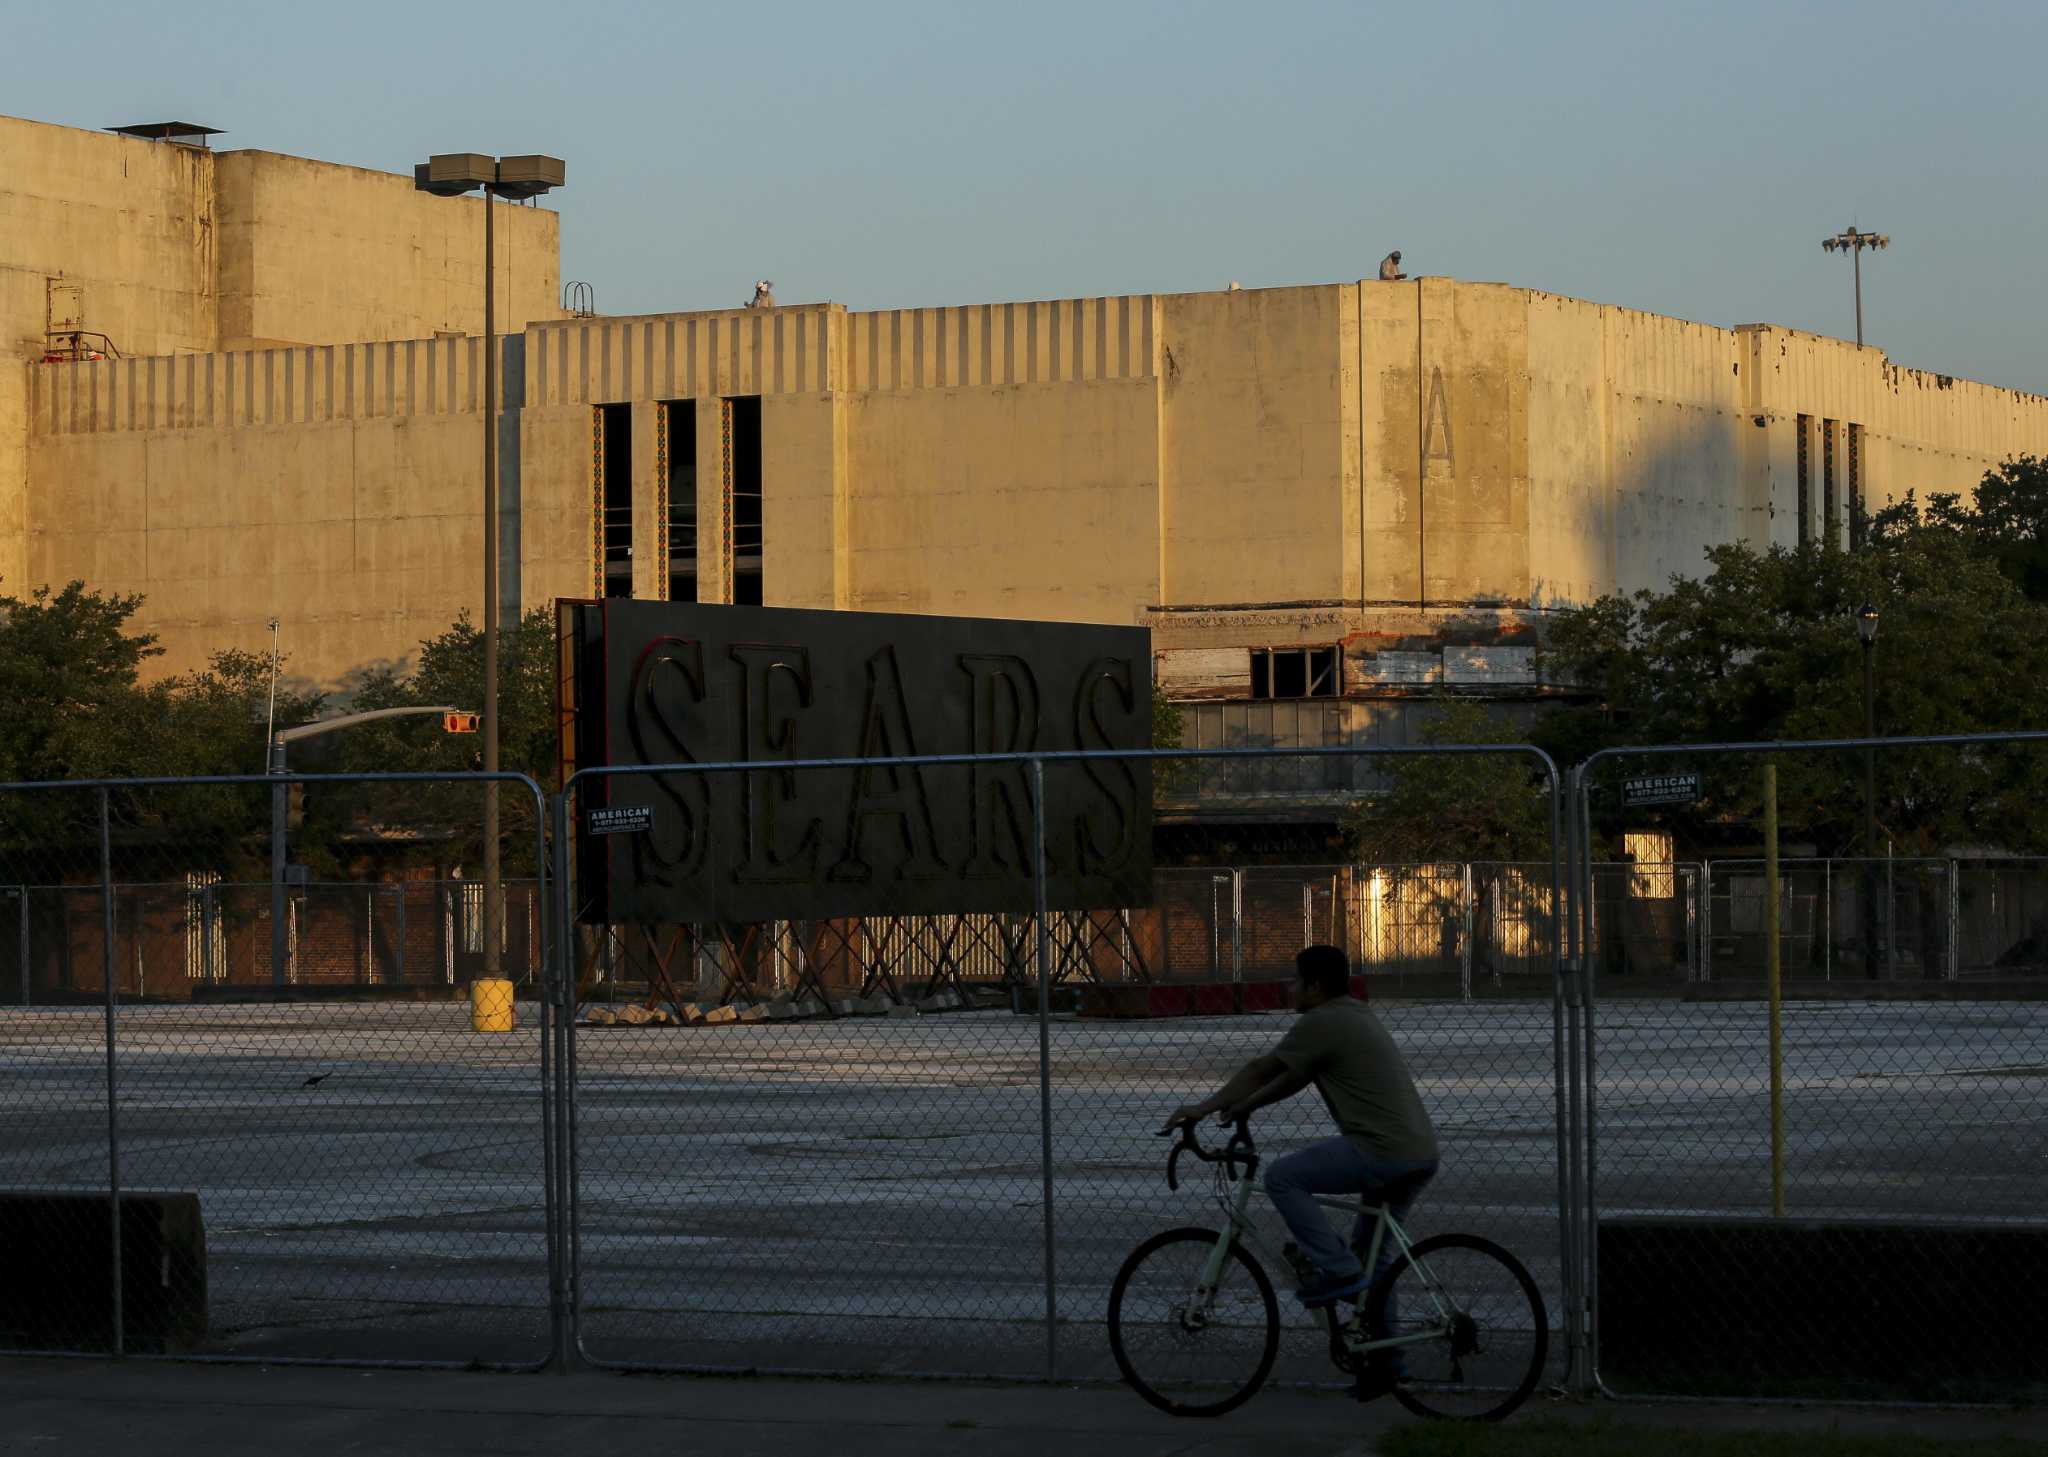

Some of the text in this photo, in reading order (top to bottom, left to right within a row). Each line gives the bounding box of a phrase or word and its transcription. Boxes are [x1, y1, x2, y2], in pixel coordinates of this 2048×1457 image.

[629, 634, 1138, 887] SEARS
[1625, 776, 1696, 791] AMERICAN
[591, 807, 650, 820] AMERICAN
